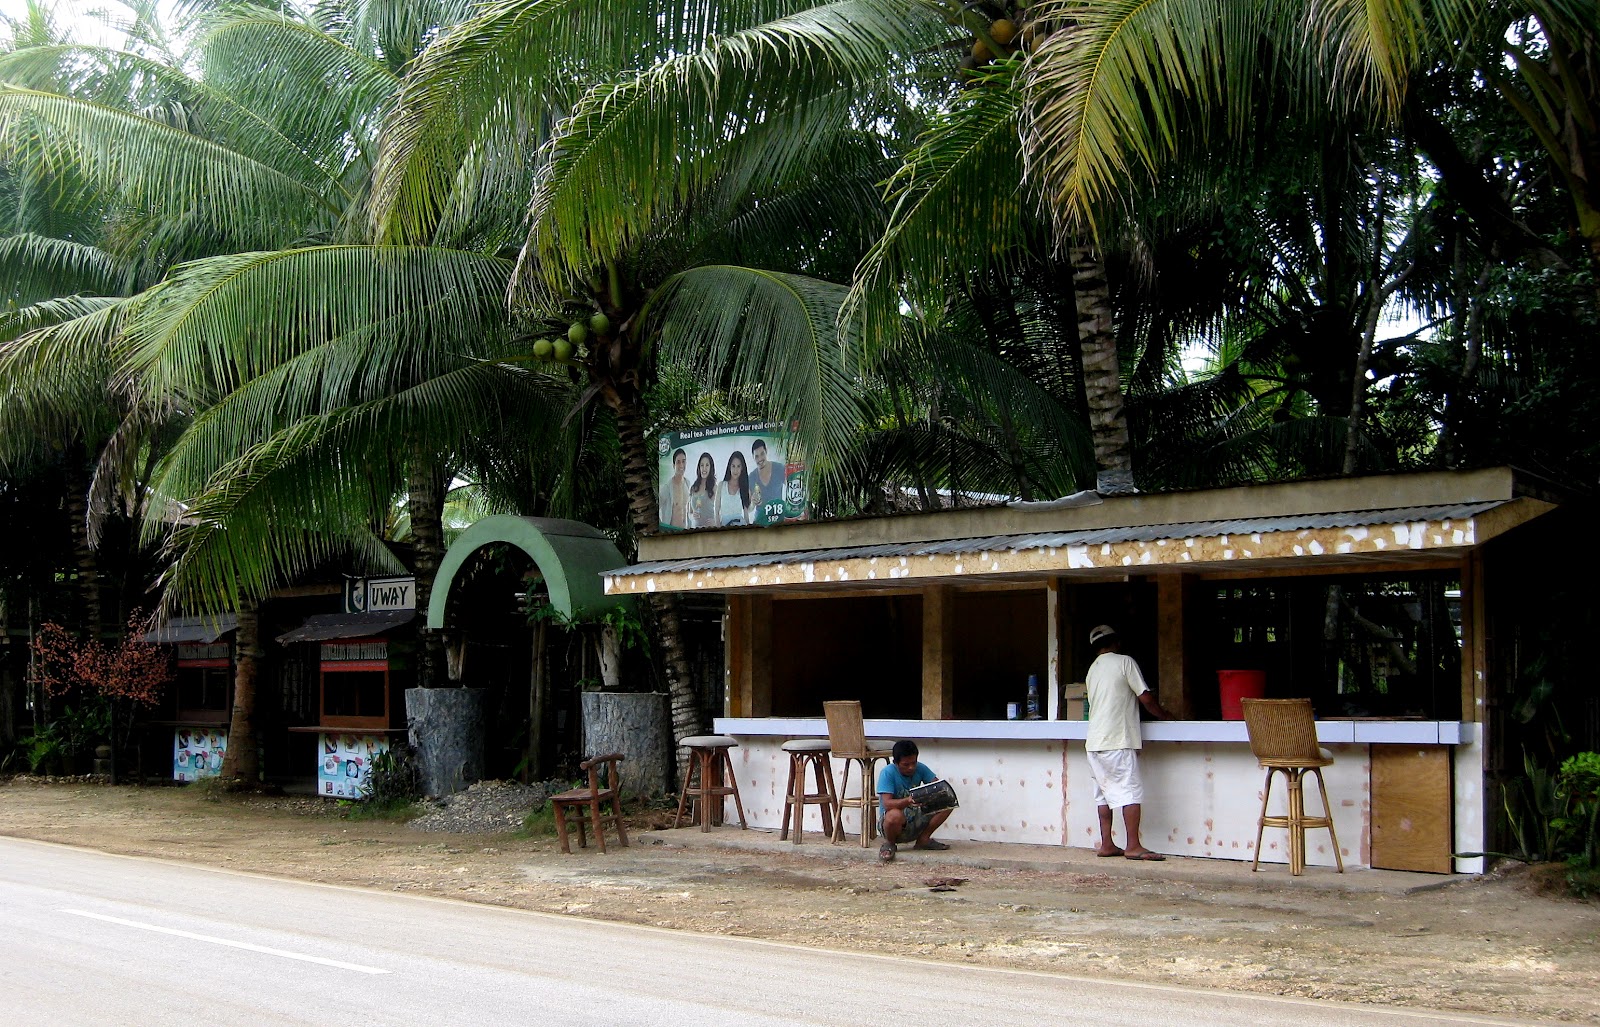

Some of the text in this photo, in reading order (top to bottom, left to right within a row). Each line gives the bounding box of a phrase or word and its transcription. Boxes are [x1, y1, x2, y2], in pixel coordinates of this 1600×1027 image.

[680, 431, 692, 440] Real
[705, 428, 719, 436] Real
[719, 426, 739, 435] honey.
[739, 424, 751, 432] Our
[751, 422, 764, 430] real
[372, 585, 409, 606] UWAY
